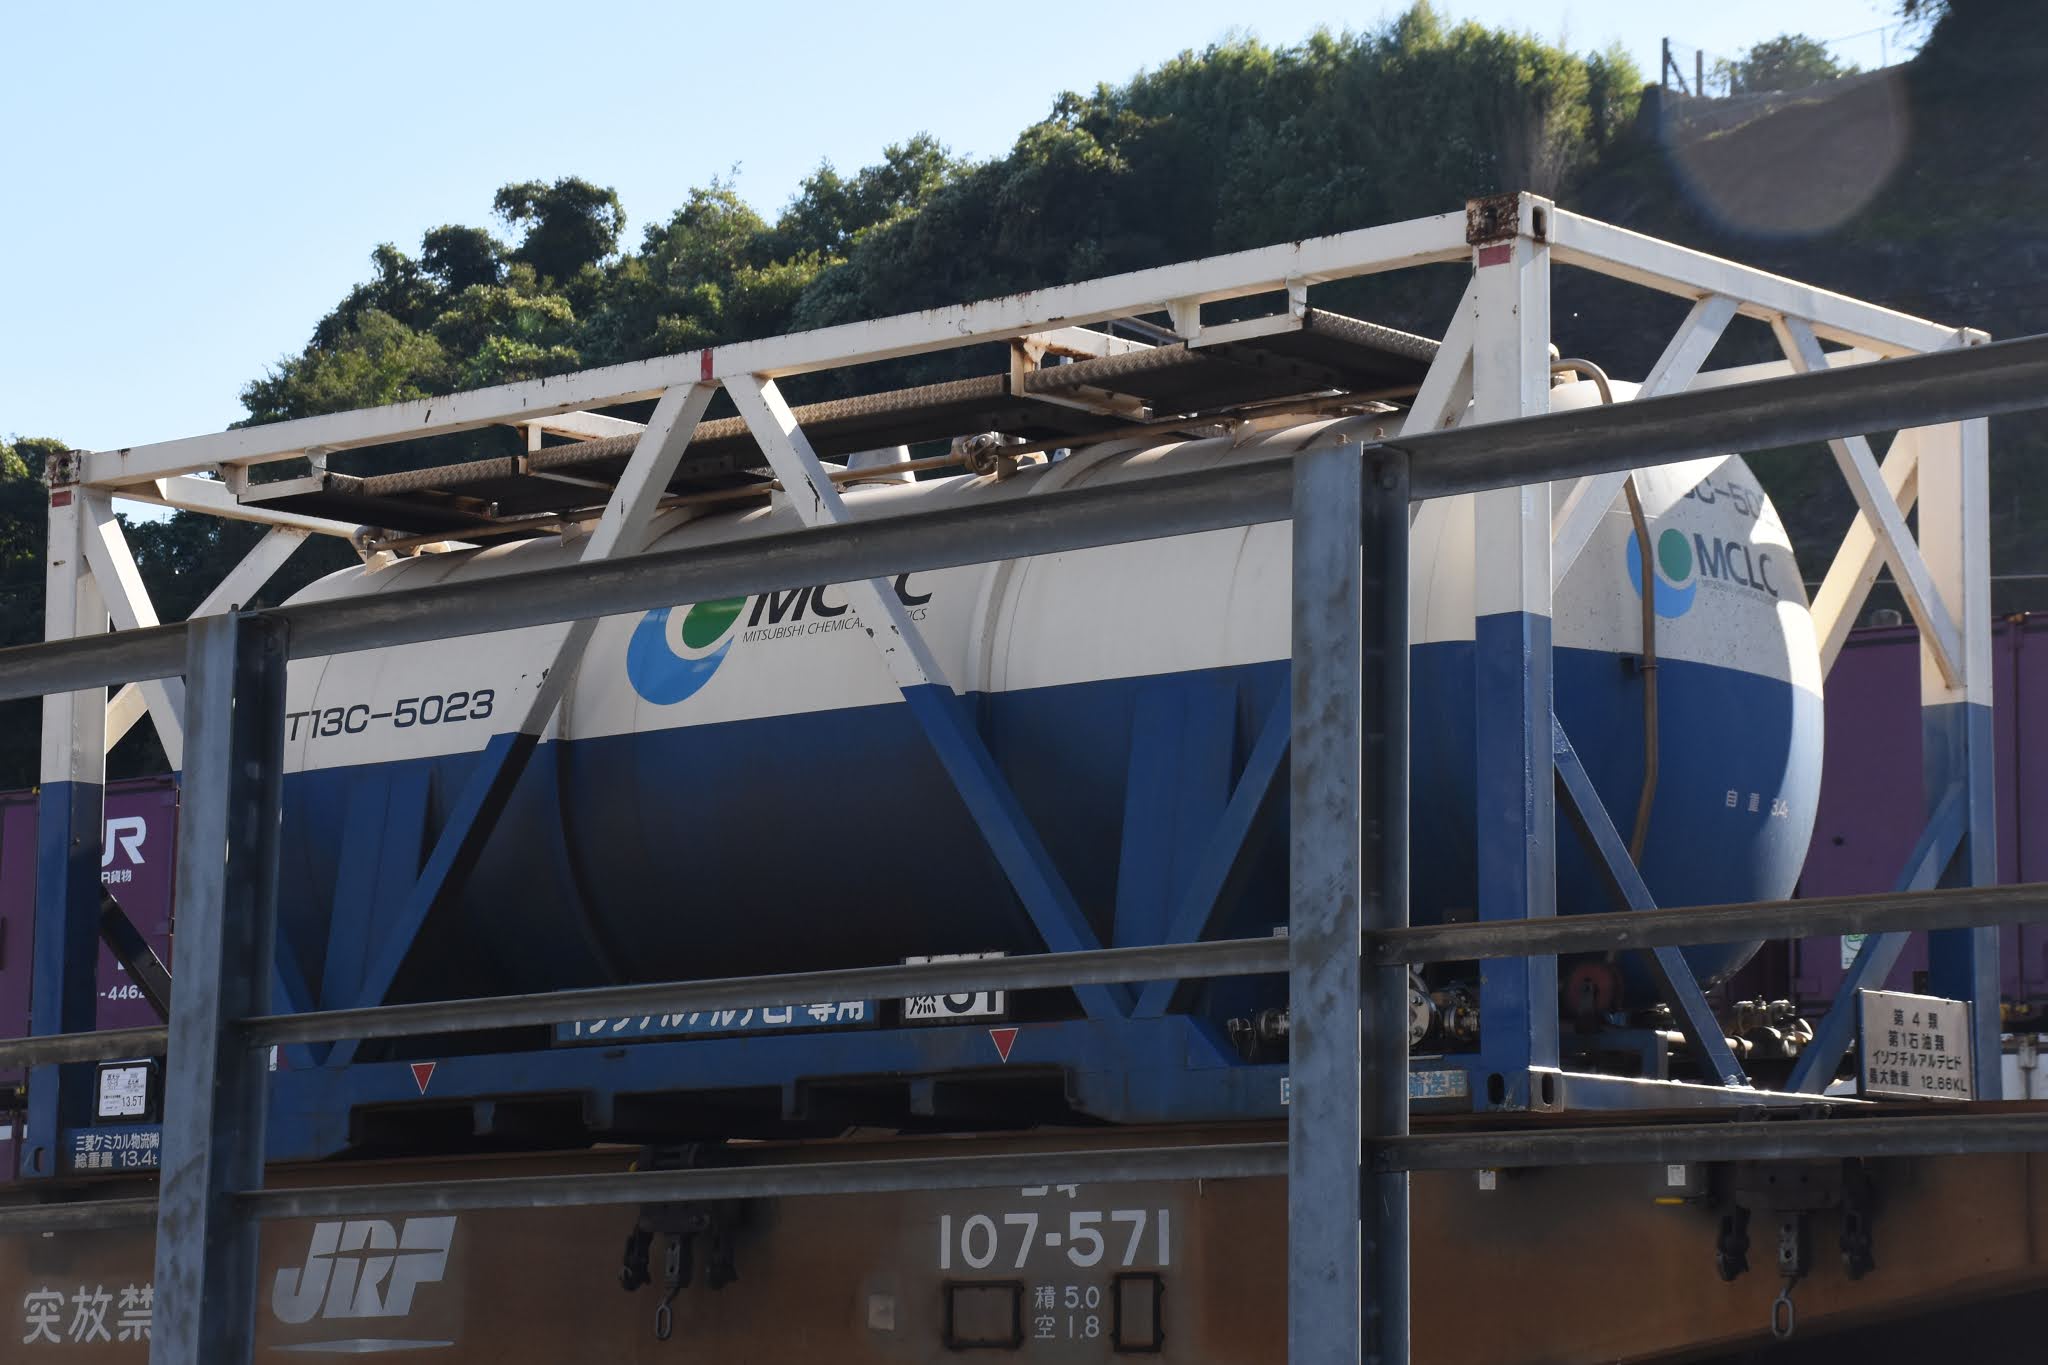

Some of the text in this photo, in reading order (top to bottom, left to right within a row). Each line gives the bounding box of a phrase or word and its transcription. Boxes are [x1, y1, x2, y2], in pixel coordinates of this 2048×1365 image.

[1693, 532, 1778, 598] MCLC
[747, 573, 932, 628] MCC
[743, 624, 804, 643] MITSUBISHI
[286, 688, 495, 741] T13C-5023
[101, 816, 147, 868] JR
[101, 870, 132, 884] R貨物
[100, 984, 146, 1000] -446
[75, 1150, 158, 1168] 総重量 13.4t
[271, 1215, 458, 1325] JRF
[22, 1283, 154, 1344] 突放禁
[1035, 1286, 1101, 1310] 積 5.0
[1034, 1314, 1101, 1339] 空 1.8
